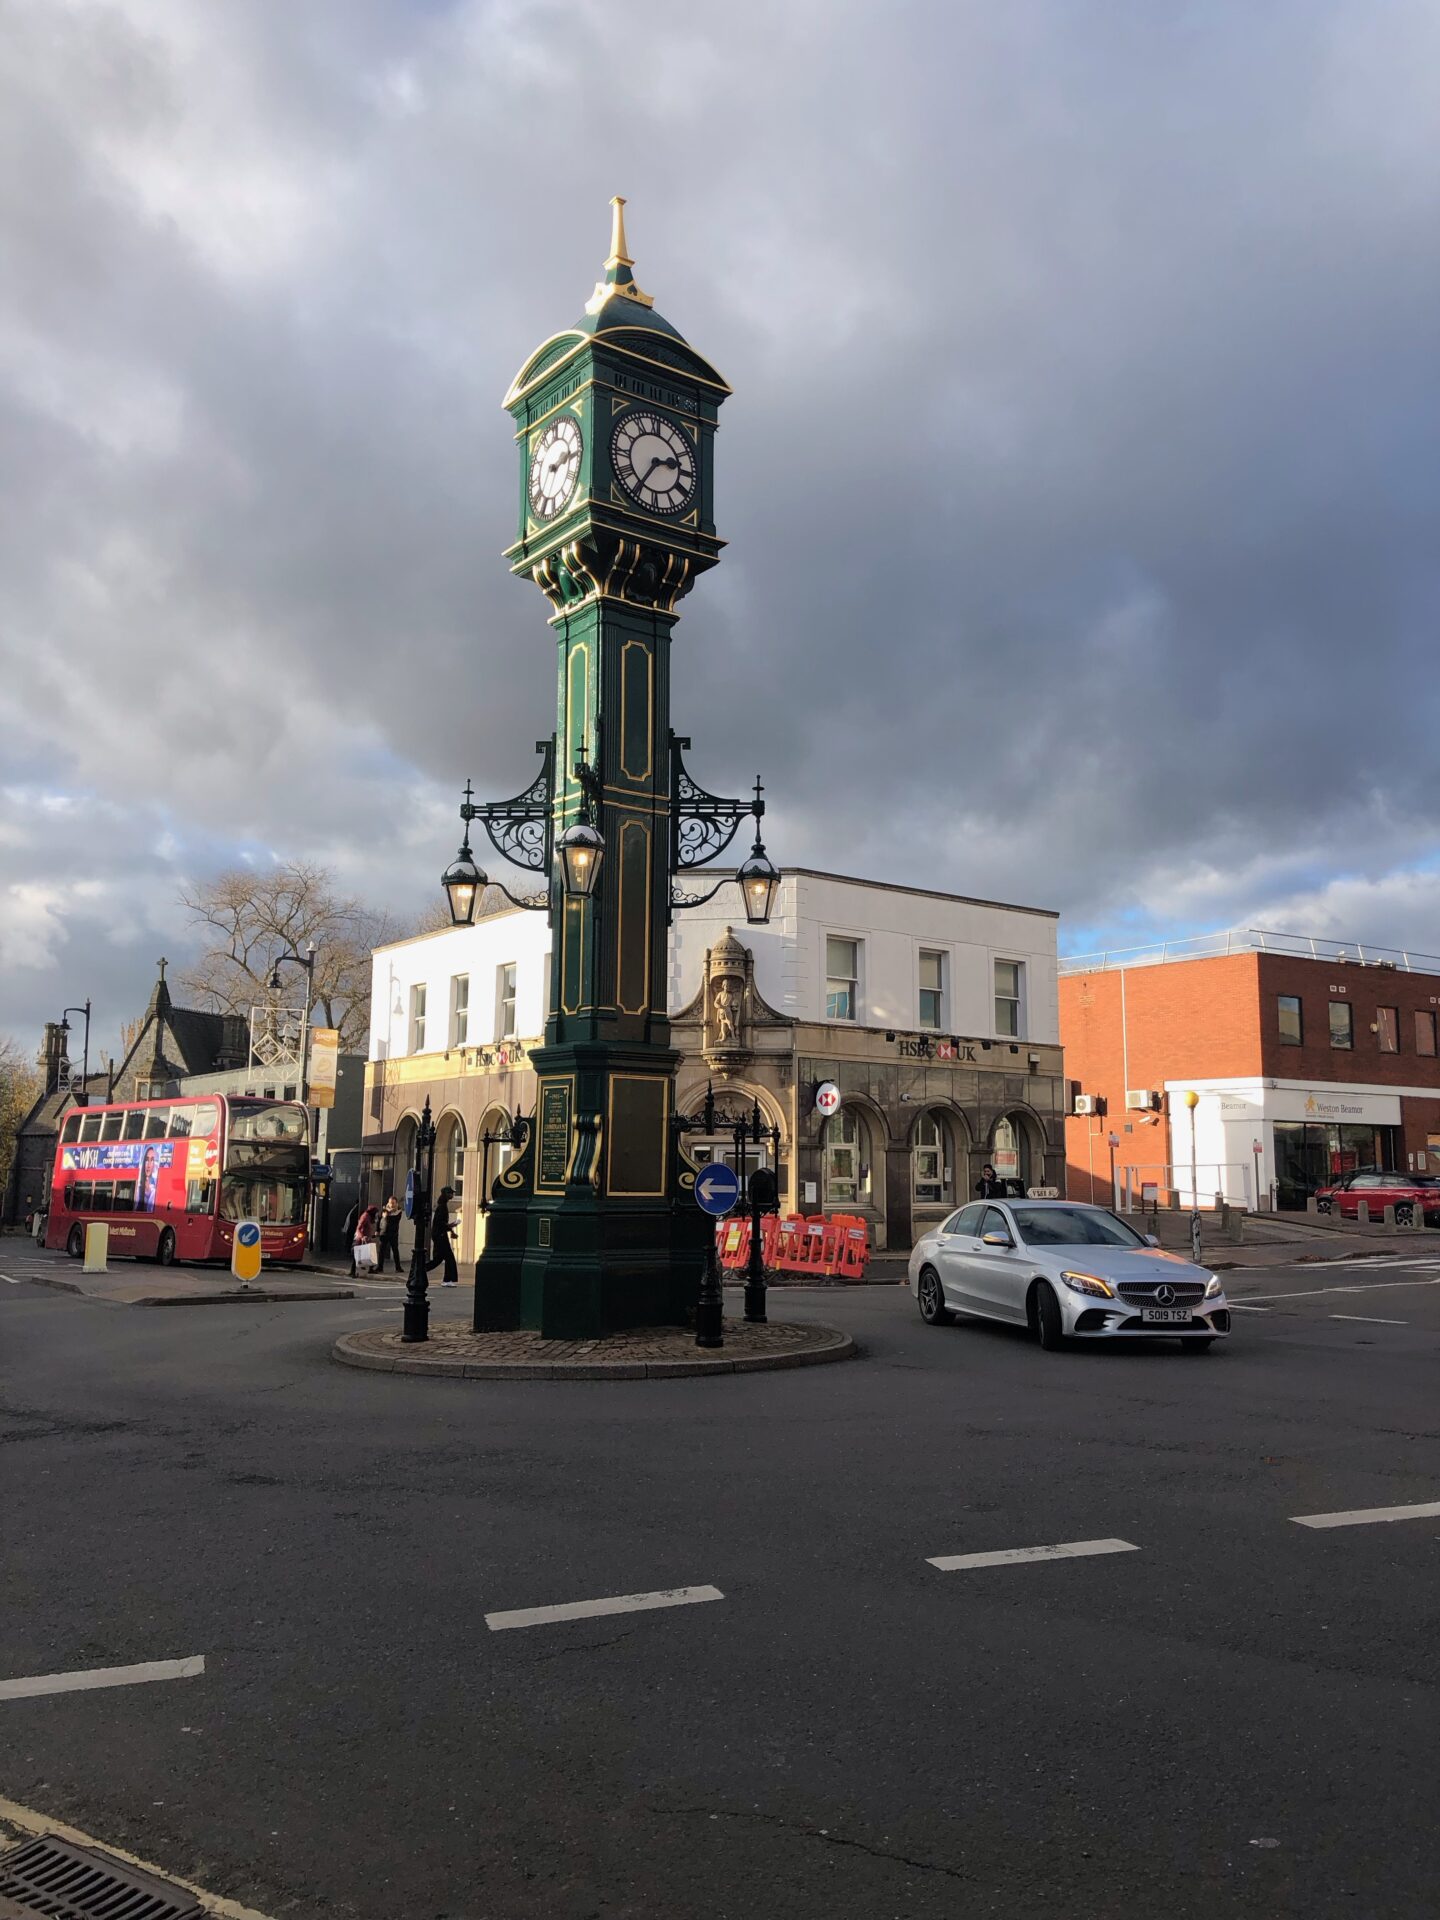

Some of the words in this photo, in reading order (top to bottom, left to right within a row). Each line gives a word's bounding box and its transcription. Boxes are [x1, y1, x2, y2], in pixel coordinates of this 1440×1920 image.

[509, 1048, 521, 1063] UK
[899, 1041, 936, 1060] HSBC
[957, 1046, 977, 1062] UK
[1317, 1103, 1340, 1113] Weston
[1340, 1104, 1363, 1115] Beamor
[80, 1148, 99, 1168] WISH
[1149, 1311, 1169, 1320] SO19
[1171, 1311, 1187, 1320] TSZ
